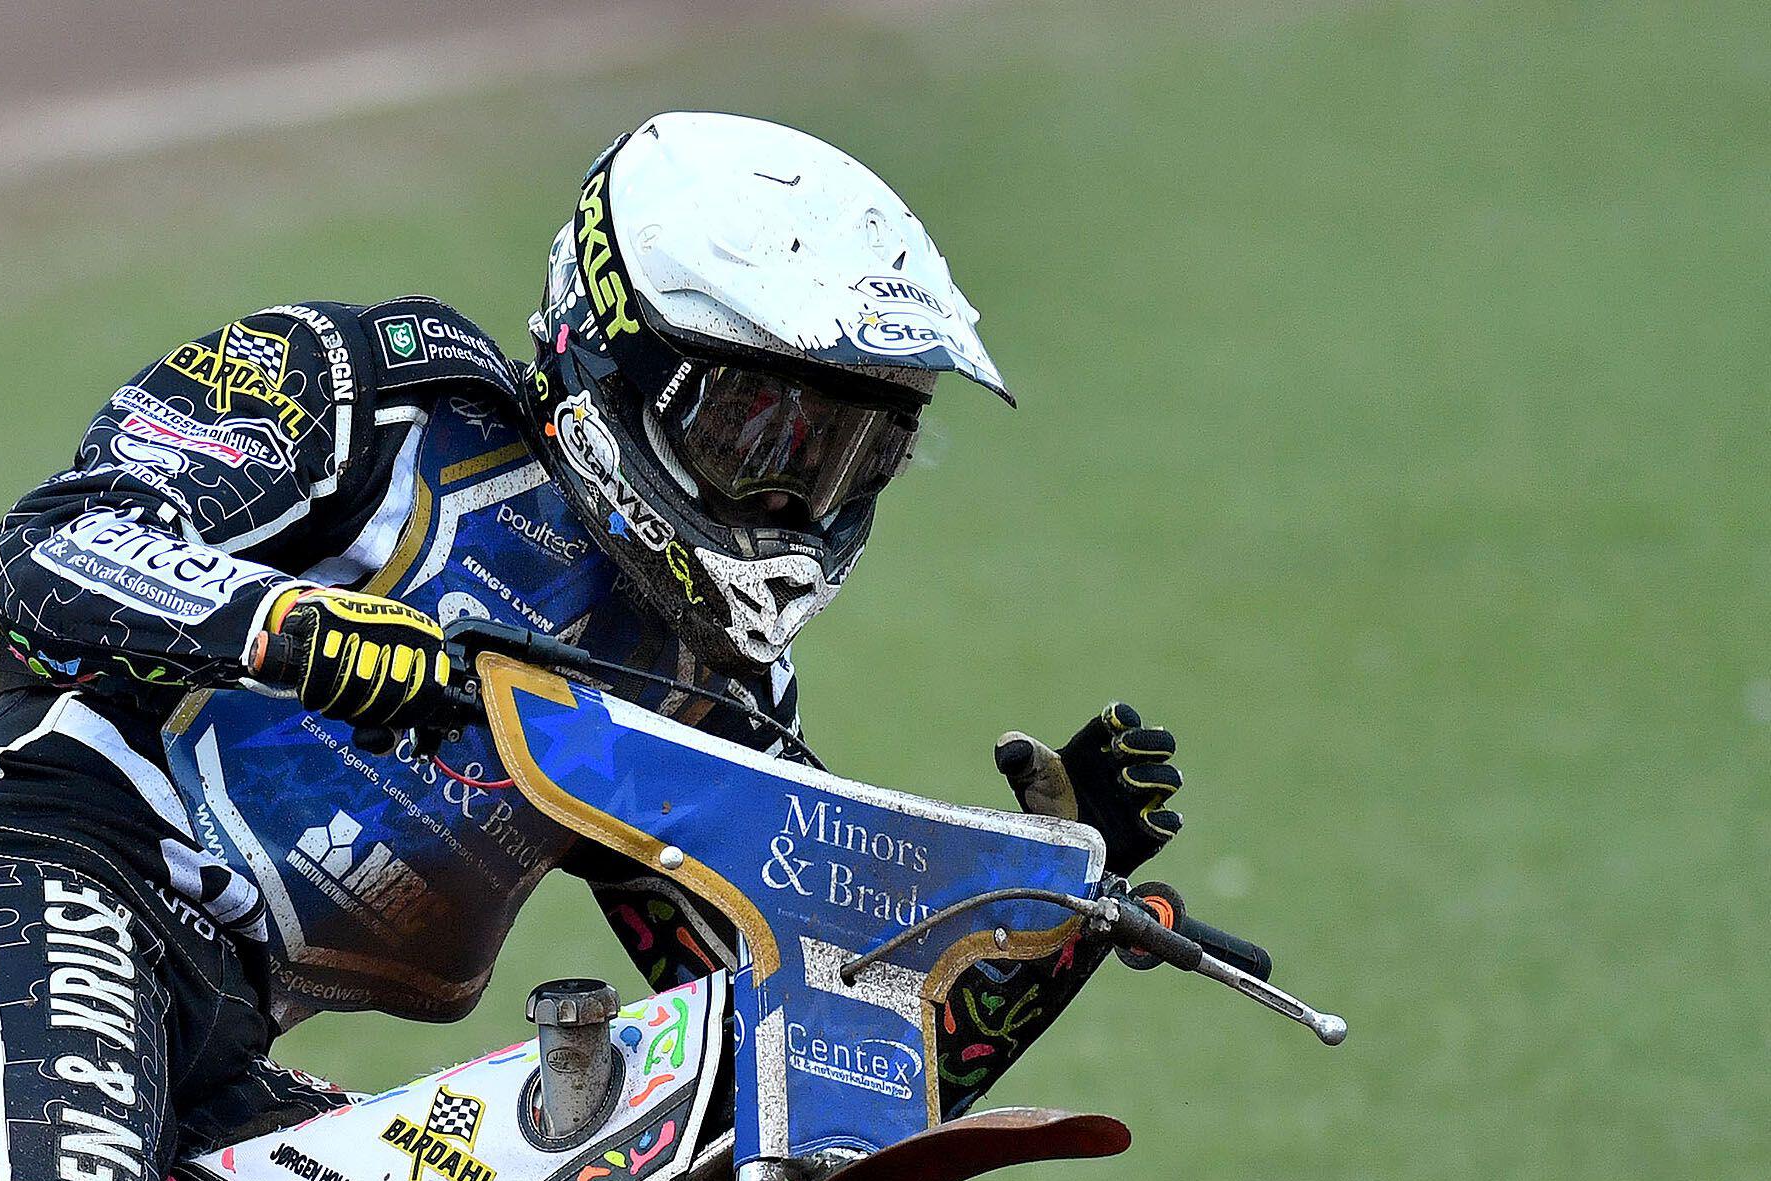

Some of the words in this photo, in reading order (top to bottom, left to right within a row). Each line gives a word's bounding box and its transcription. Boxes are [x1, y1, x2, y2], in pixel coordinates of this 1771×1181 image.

[870, 282, 944, 314] SHOEI
[656, 361, 692, 412] OAKLEY
[497, 503, 581, 560] poultec
[462, 556, 513, 600] KING'S
[512, 594, 555, 633] LYNN
[301, 715, 338, 749] Estate
[337, 744, 380, 785] Agents,
[382, 779, 422, 818] Lettings
[421, 811, 441, 834] and
[443, 761, 488, 819] &
[780, 793, 929, 874] Minors
[286, 850, 323, 888] MARTIN
[761, 835, 815, 896] &
[48, 879, 140, 1054] KRUSE
[55, 1055, 137, 1106] &
[787, 1022, 910, 1084] Centex
[270, 1143, 321, 1181] JØRGEN
